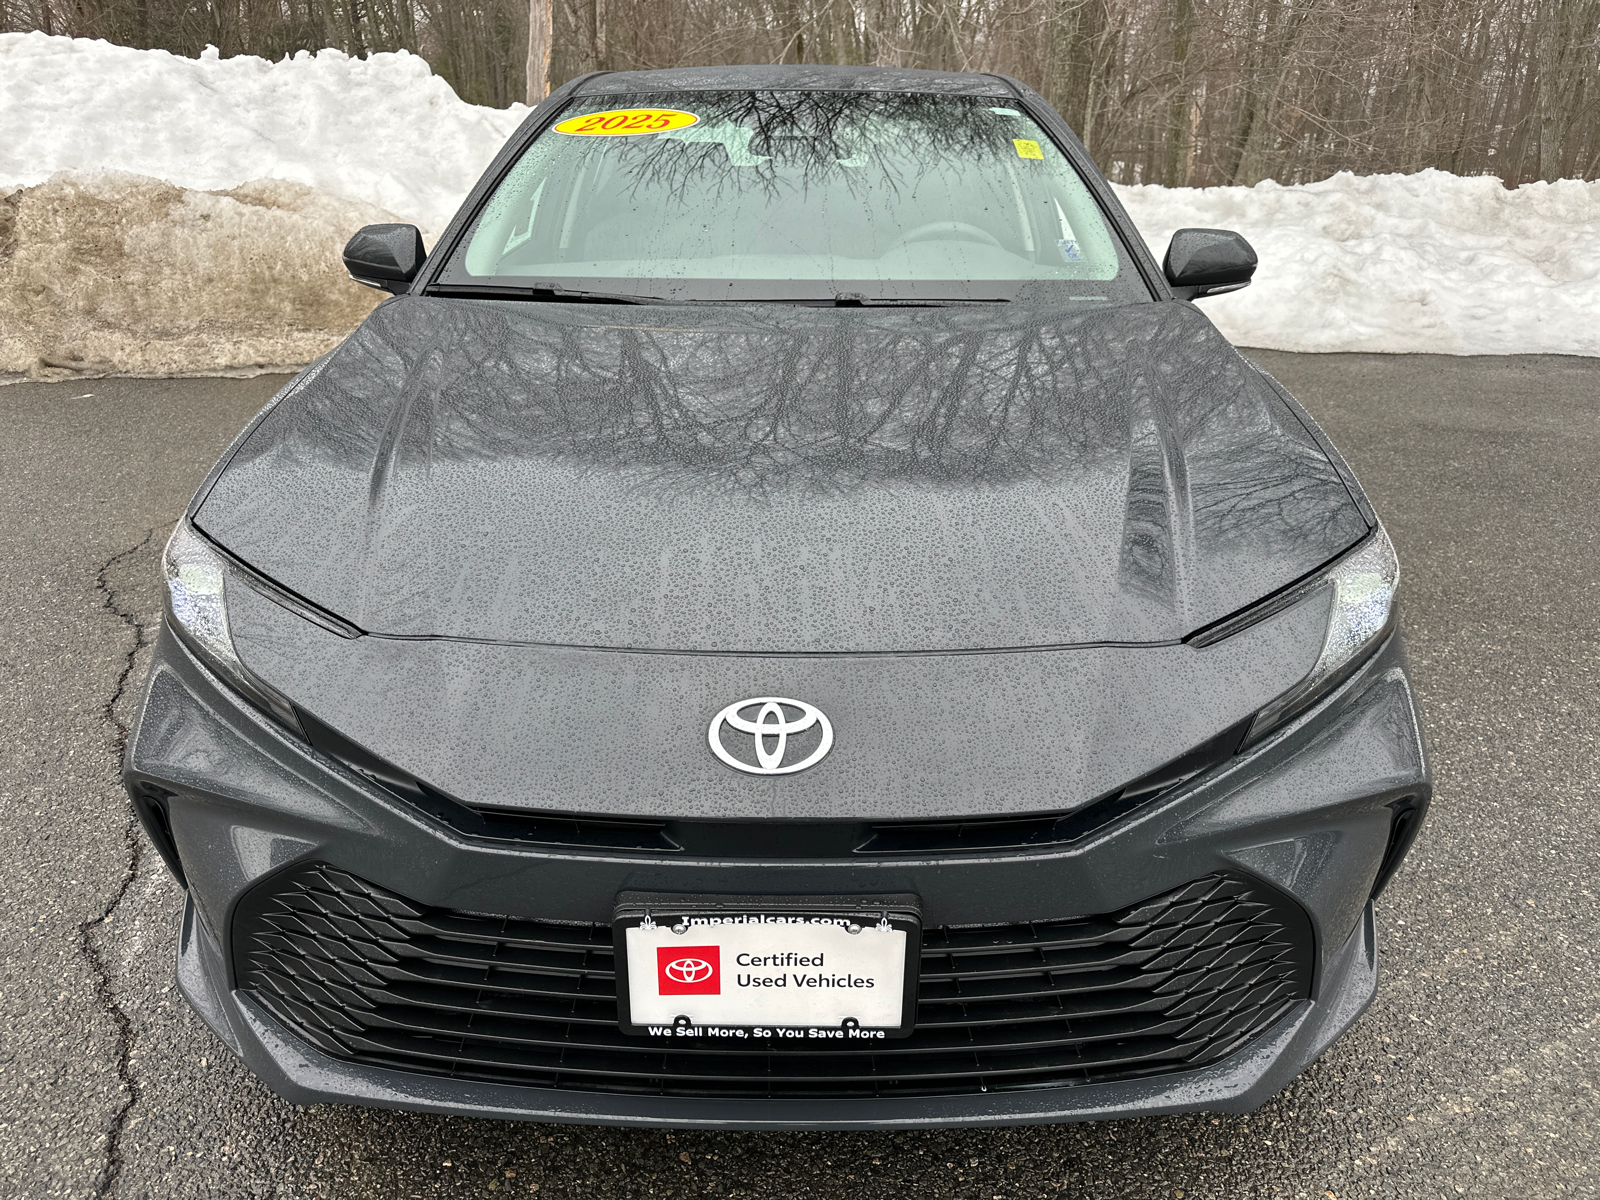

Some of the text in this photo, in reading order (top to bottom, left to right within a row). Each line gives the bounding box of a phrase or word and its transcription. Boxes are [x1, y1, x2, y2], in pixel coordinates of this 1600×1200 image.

[574, 113, 677, 132] 2025
[682, 914, 851, 927] Imperialcars.com
[736, 953, 824, 967] Certified
[737, 973, 875, 988] Used Vehicles
[648, 1026, 885, 1039] We Sell More, So You Save More
